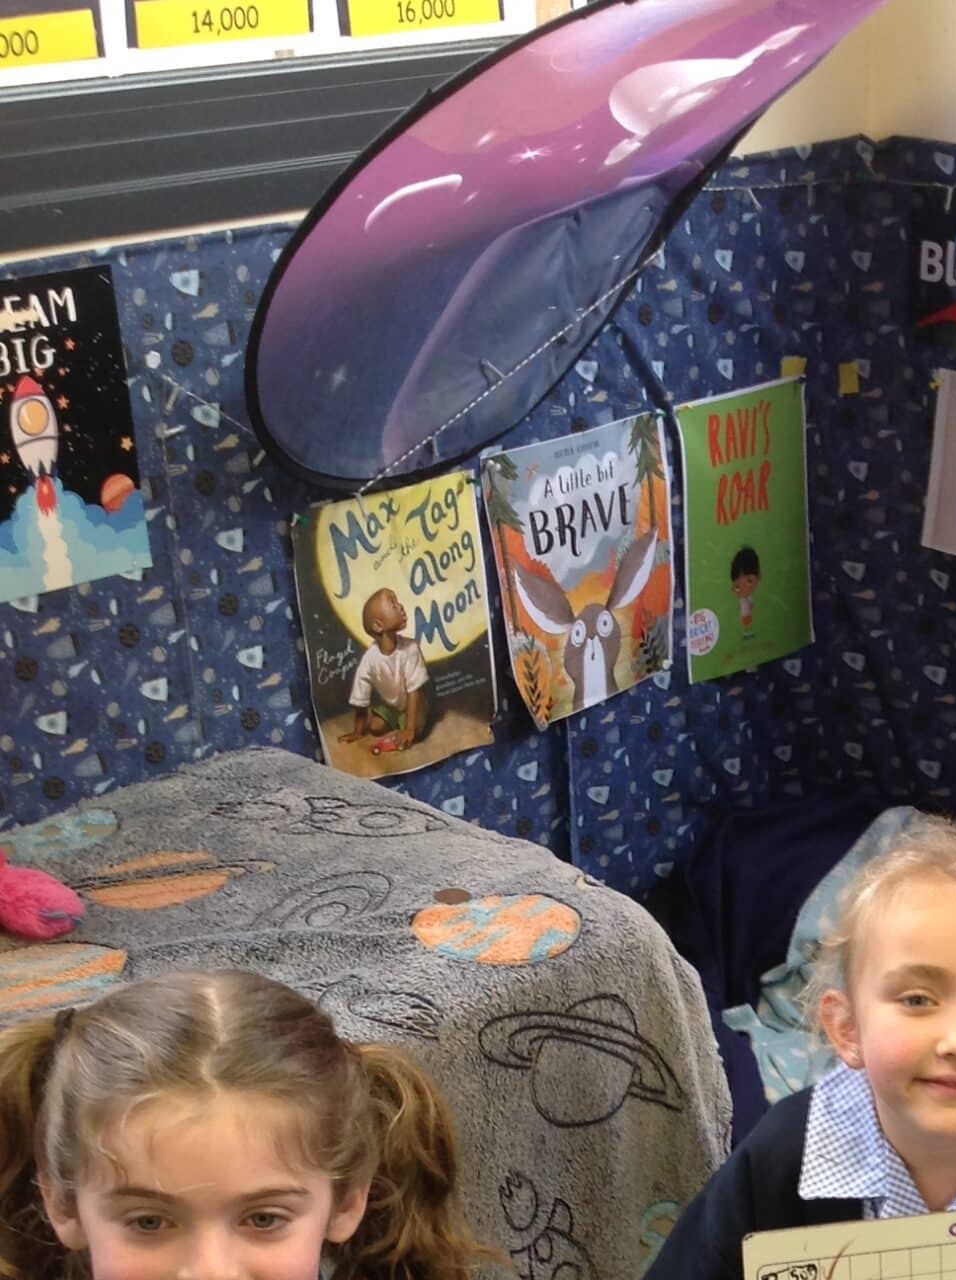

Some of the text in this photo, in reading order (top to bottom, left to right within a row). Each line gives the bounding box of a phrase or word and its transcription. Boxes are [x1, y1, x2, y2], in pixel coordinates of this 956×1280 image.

[191, 10, 260, 36] 14,000
[397, 0, 456, 24] 16,000
[707, 402, 772, 469] RAVI'S
[529, 482, 632, 557] BRAVE
[543, 477, 554, 499] A
[715, 459, 772, 526] ROAR
[328, 496, 401, 599] Max
[413, 578, 482, 653] Moon
